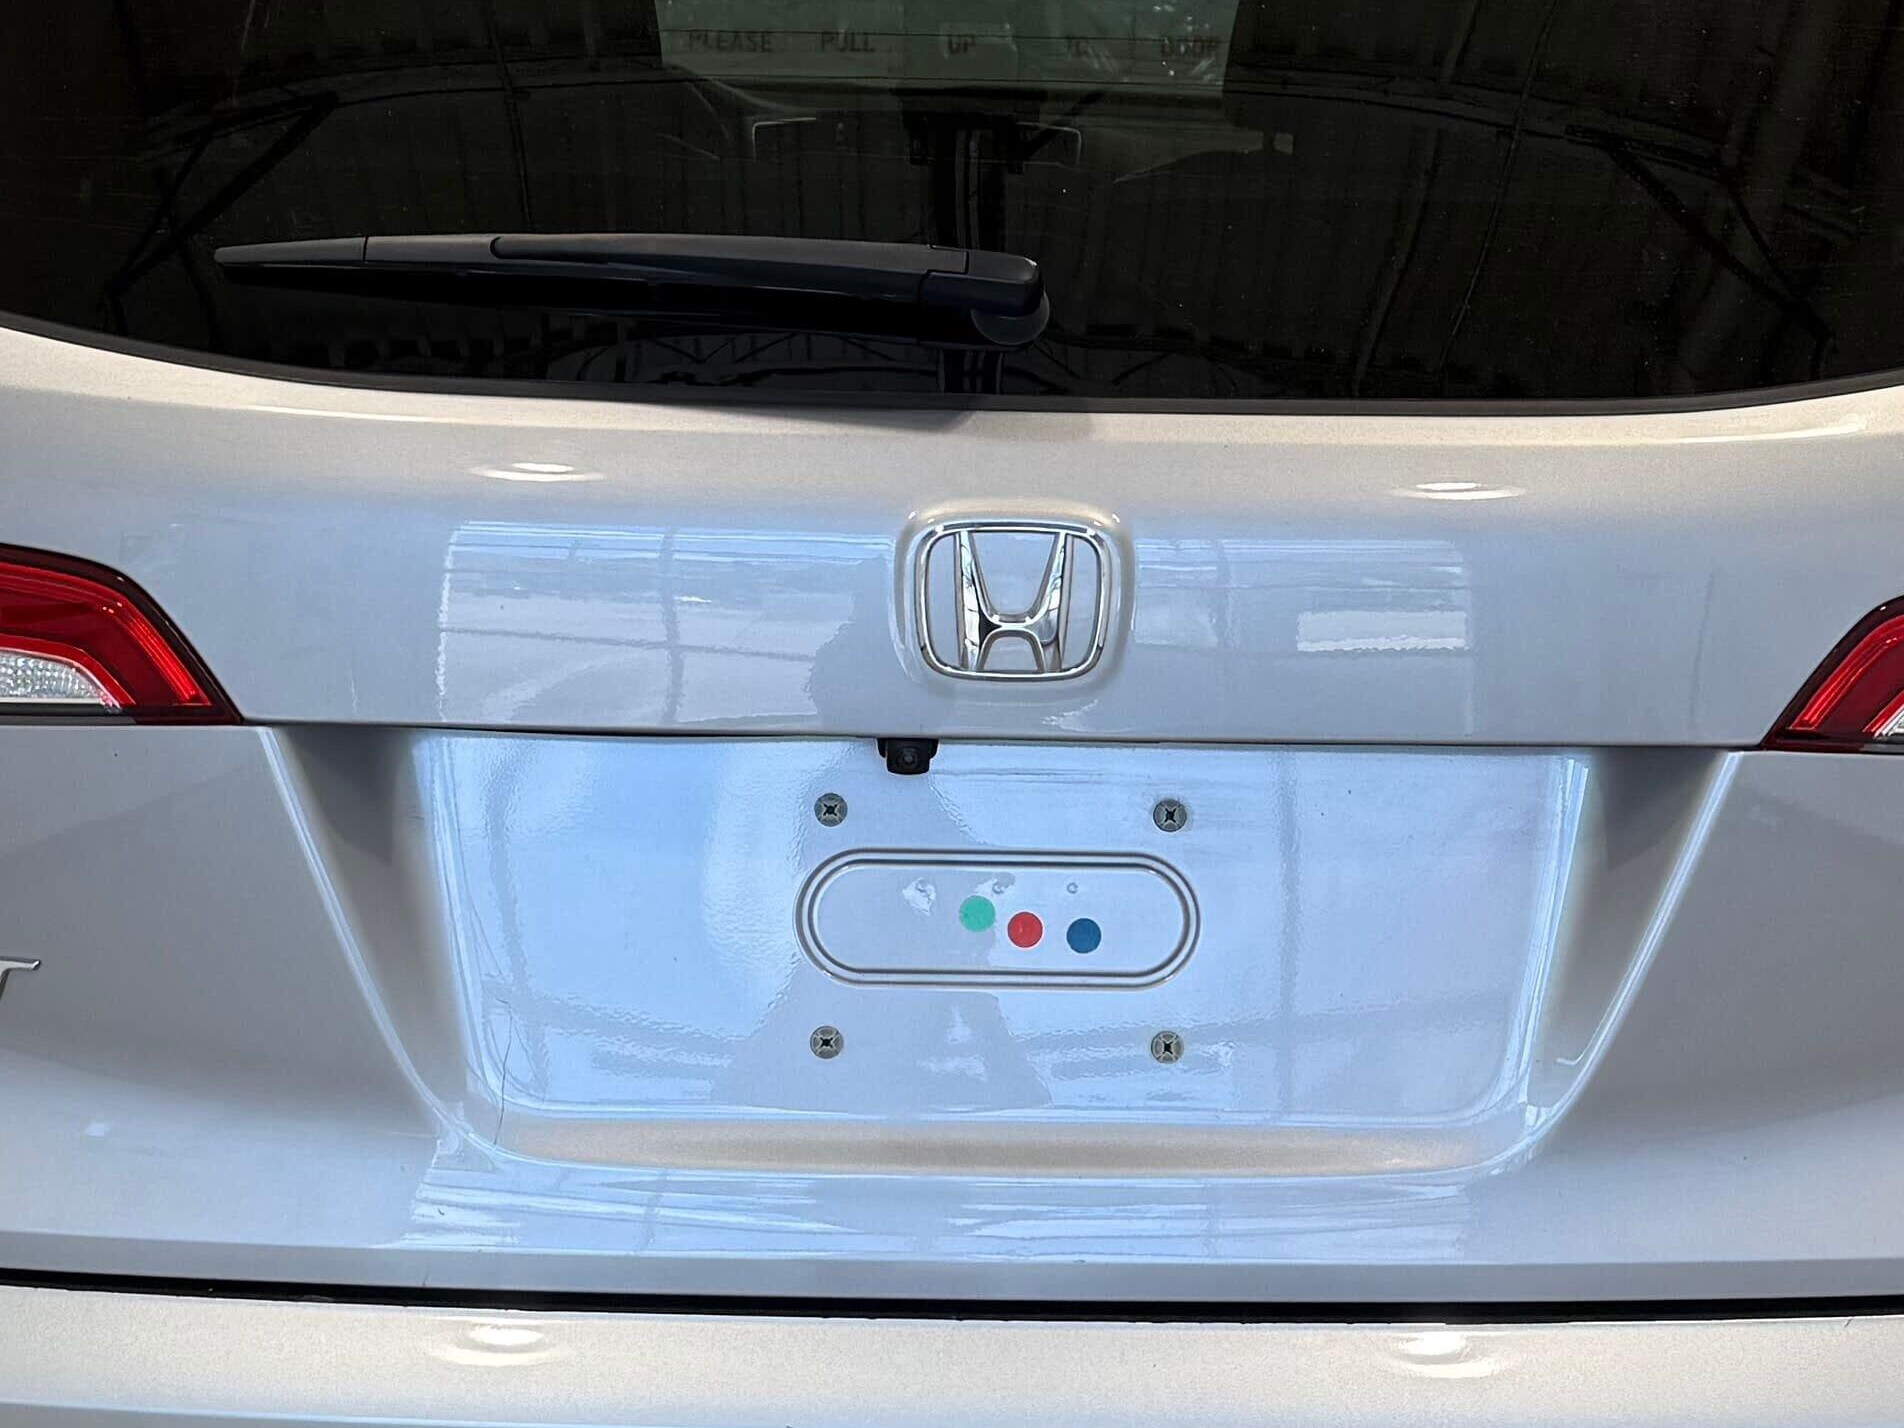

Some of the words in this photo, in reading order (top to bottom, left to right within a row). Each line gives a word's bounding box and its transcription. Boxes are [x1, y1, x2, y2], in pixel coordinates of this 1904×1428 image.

[689, 32, 774, 53] PLEASE
[821, 33, 874, 54] PULL
[948, 35, 976, 55] UP
